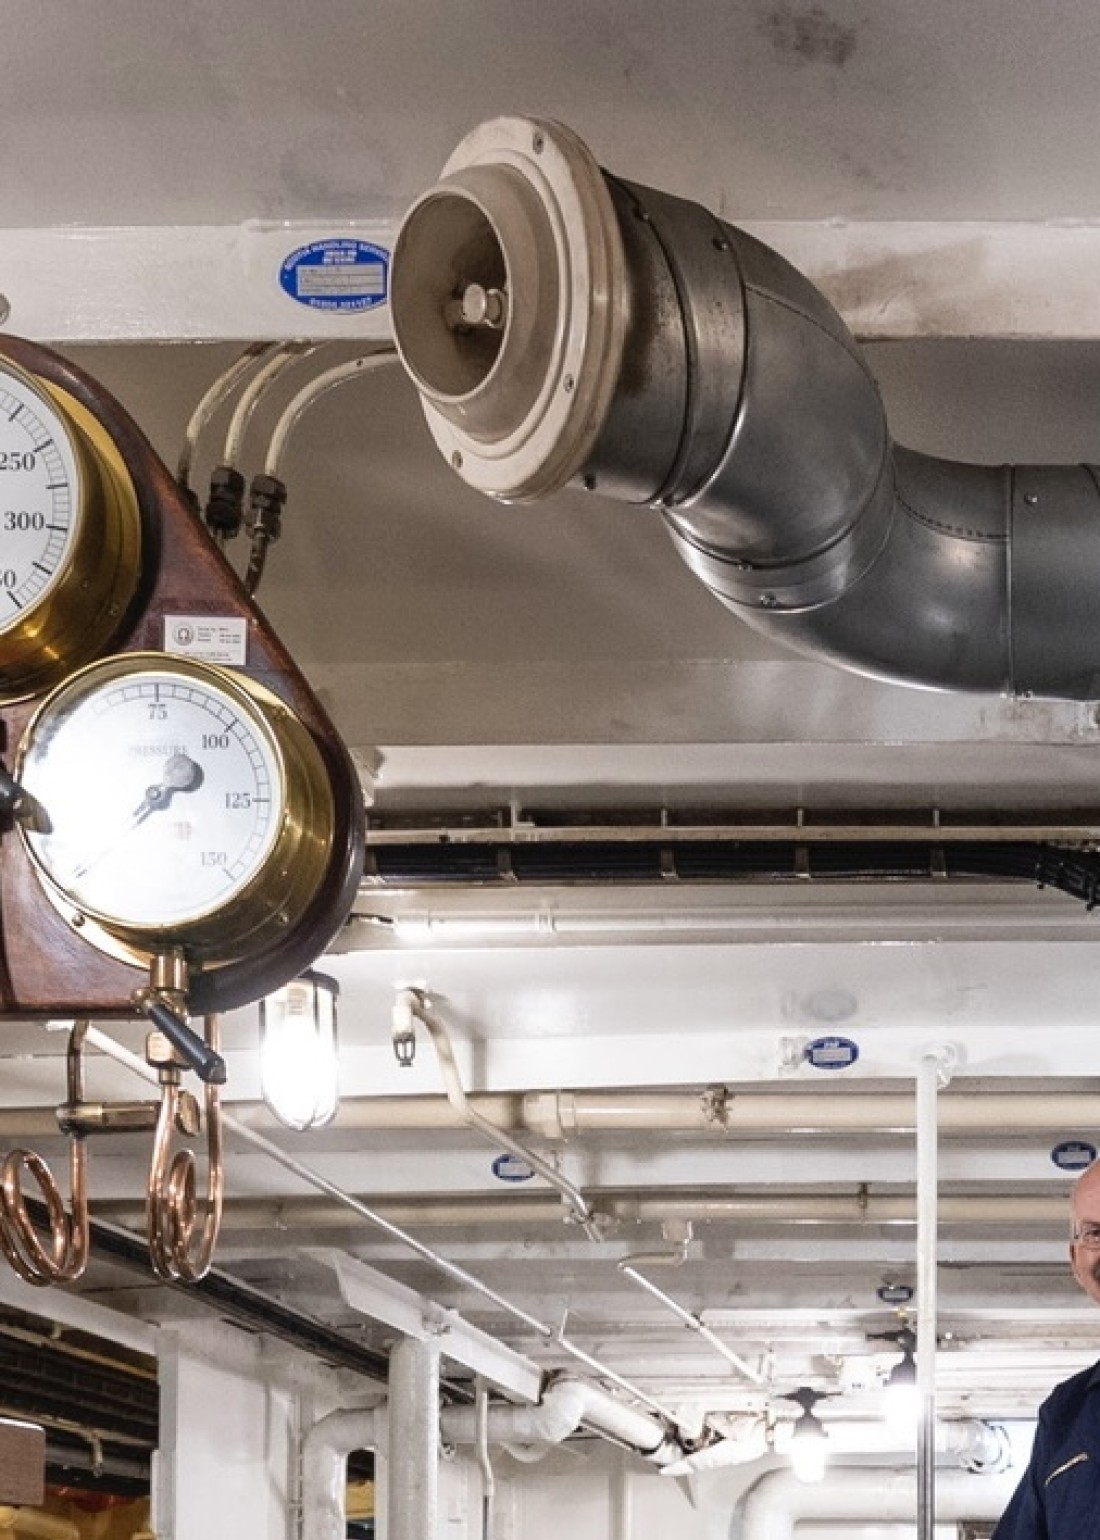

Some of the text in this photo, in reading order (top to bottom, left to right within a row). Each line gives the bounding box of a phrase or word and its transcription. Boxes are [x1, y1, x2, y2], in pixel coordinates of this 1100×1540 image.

[4, 511, 45, 531] 300
[147, 703, 168, 721] 75
[201, 733, 230, 750] 100
[224, 792, 251, 810] 125
[200, 851, 228, 867] 150
